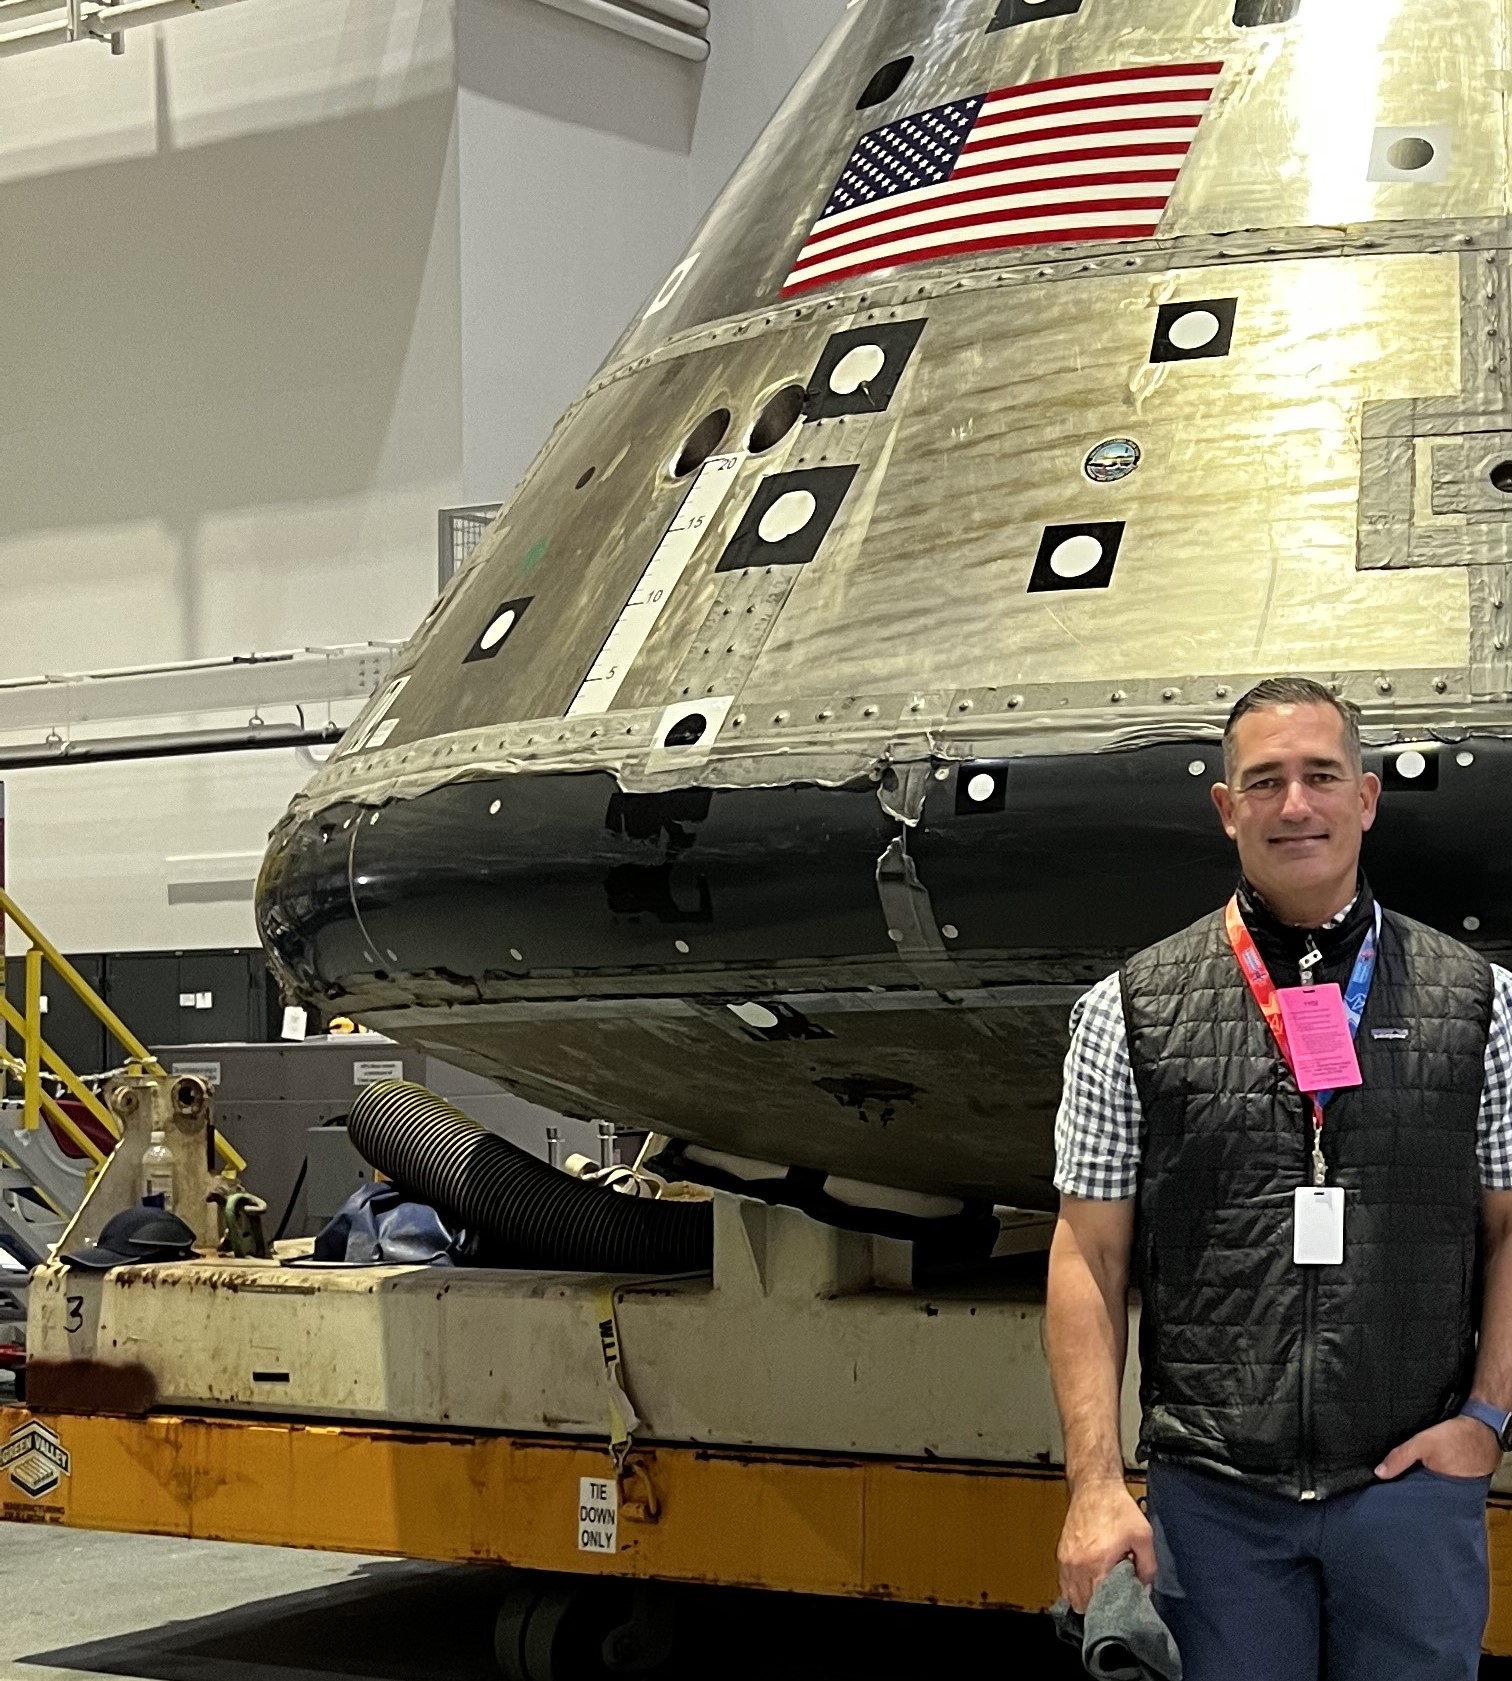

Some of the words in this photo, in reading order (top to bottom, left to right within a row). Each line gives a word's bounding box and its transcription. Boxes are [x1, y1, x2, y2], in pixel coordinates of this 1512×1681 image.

[718, 457, 738, 470] 20
[687, 515, 706, 529] 15
[646, 589, 663, 604] 10
[605, 666, 618, 680] 5
[63, 1296, 83, 1333] 3
[34, 1434, 67, 1467] VALLEY
[590, 1483, 607, 1500] TIE
[581, 1506, 615, 1525] DOWN
[582, 1530, 613, 1549] ONLY
